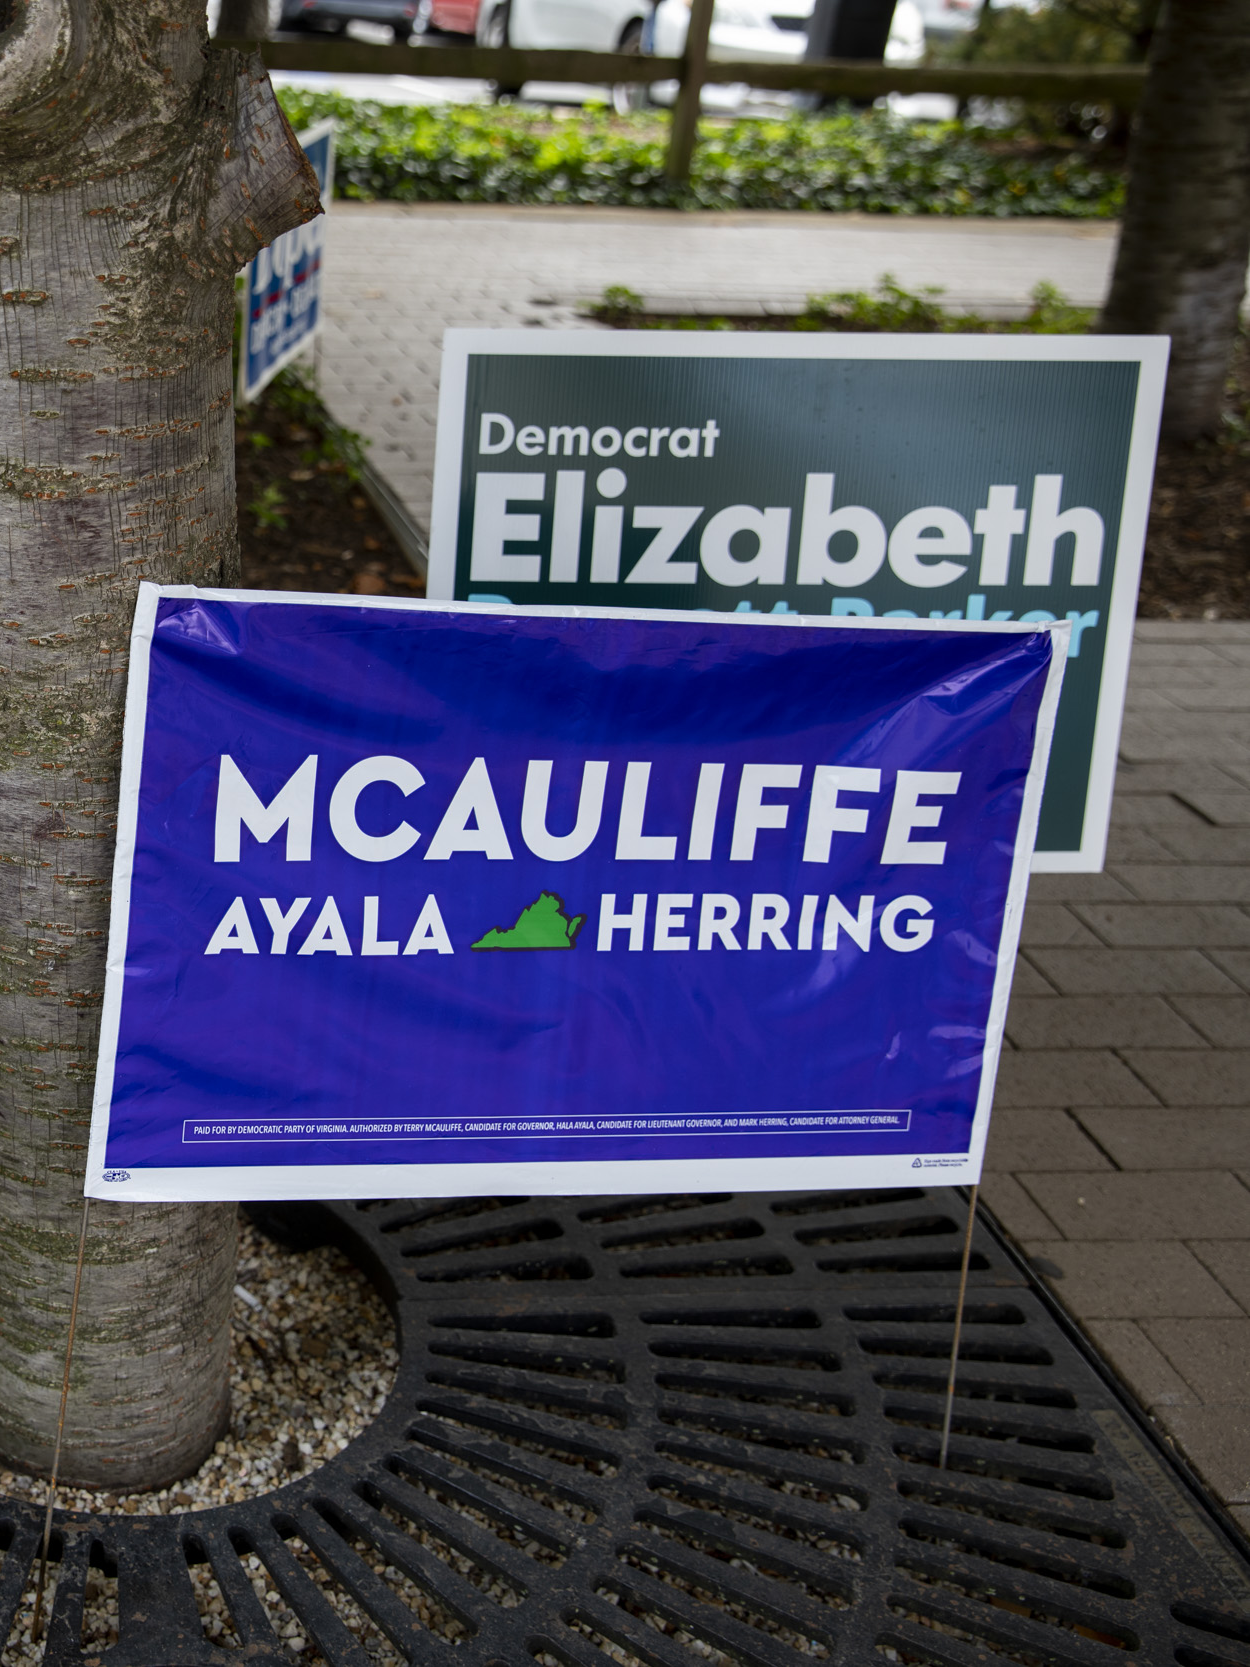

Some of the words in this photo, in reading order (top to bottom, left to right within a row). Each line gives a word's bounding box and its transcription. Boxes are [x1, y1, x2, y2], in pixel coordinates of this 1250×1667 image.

[478, 412, 720, 458] Democrat
[469, 467, 1105, 589] Elizabeth
[213, 754, 962, 866] MCAULIFFE
[203, 893, 455, 956] AYALA
[596, 893, 934, 953] HERRING
[193, 1126, 211, 1135] PAID
[212, 1126, 226, 1134] FOR
[228, 1126, 237, 1134] BY
[237, 1125, 283, 1134] DEMOCRATIC
[284, 1125, 305, 1134] PARTY
[305, 1125, 316, 1133] OF
[316, 1124, 349, 1133] VIRGINIA.
[350, 1124, 393, 1133] AUTHORIZED
[393, 1124, 402, 1132] BY
[403, 1123, 424, 1132] TERRY
[425, 1123, 464, 1132] MCAULIFFE,
[464, 1122, 502, 1132] CANDIDATE
[502, 1122, 516, 1131] FOR
[517, 1121, 555, 1131] GOVERNOR,
[556, 1121, 573, 1130] HALA
[574, 1121, 595, 1130] AYALA,
[596, 1120, 633, 1129] CANDIDATE
[633, 1120, 646, 1129] FOR
[647, 1119, 685, 1129] LIEUTENANT
[686, 1119, 723, 1128] GOVERNOR,
[723, 1118, 737, 1127] AND
[739, 1117, 758, 1126] MARK
[758, 1117, 789, 1127] HERRING,
[789, 1117, 824, 1126] CANDIDATE
[825, 1116, 837, 1125] FOR
[838, 1116, 869, 1125] ATTORNEY
[870, 1115, 900, 1124] GENERAL.
